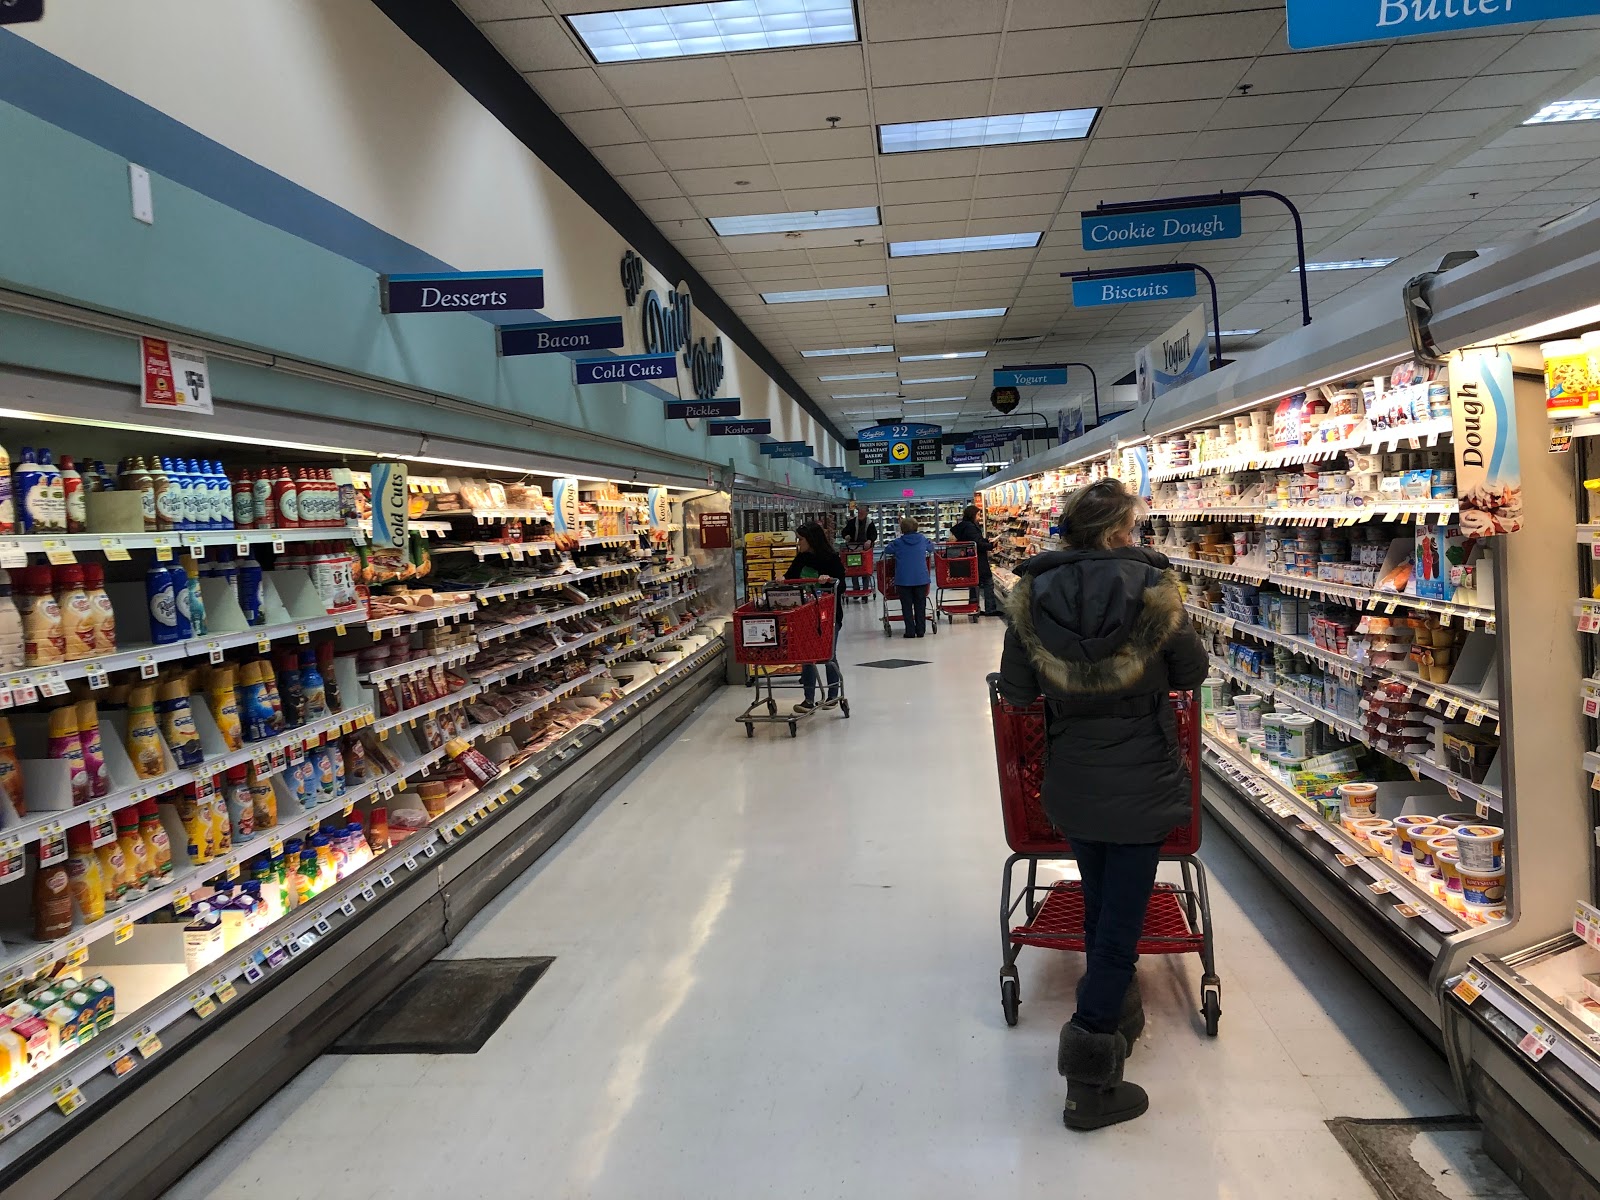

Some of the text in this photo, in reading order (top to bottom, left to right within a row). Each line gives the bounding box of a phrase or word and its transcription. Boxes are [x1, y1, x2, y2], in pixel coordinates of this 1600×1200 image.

[1091, 215, 1225, 243] Cookie Dough
[420, 287, 508, 308] Desserts
[1101, 283, 1168, 301] Biscuits
[536, 332, 591, 350] Bacon
[1162, 329, 1191, 375] Yogurt
[592, 362, 663, 380] Cold Cuts
[1013, 374, 1048, 385] Yogurt
[686, 406, 720, 416] Pickles
[724, 424, 755, 434] Kosher
[892, 425, 908, 437] 22
[1457, 381, 1486, 469] Dough
[391, 473, 404, 548] Cold Cuts
[566, 483, 576, 530] Hot Dogs
